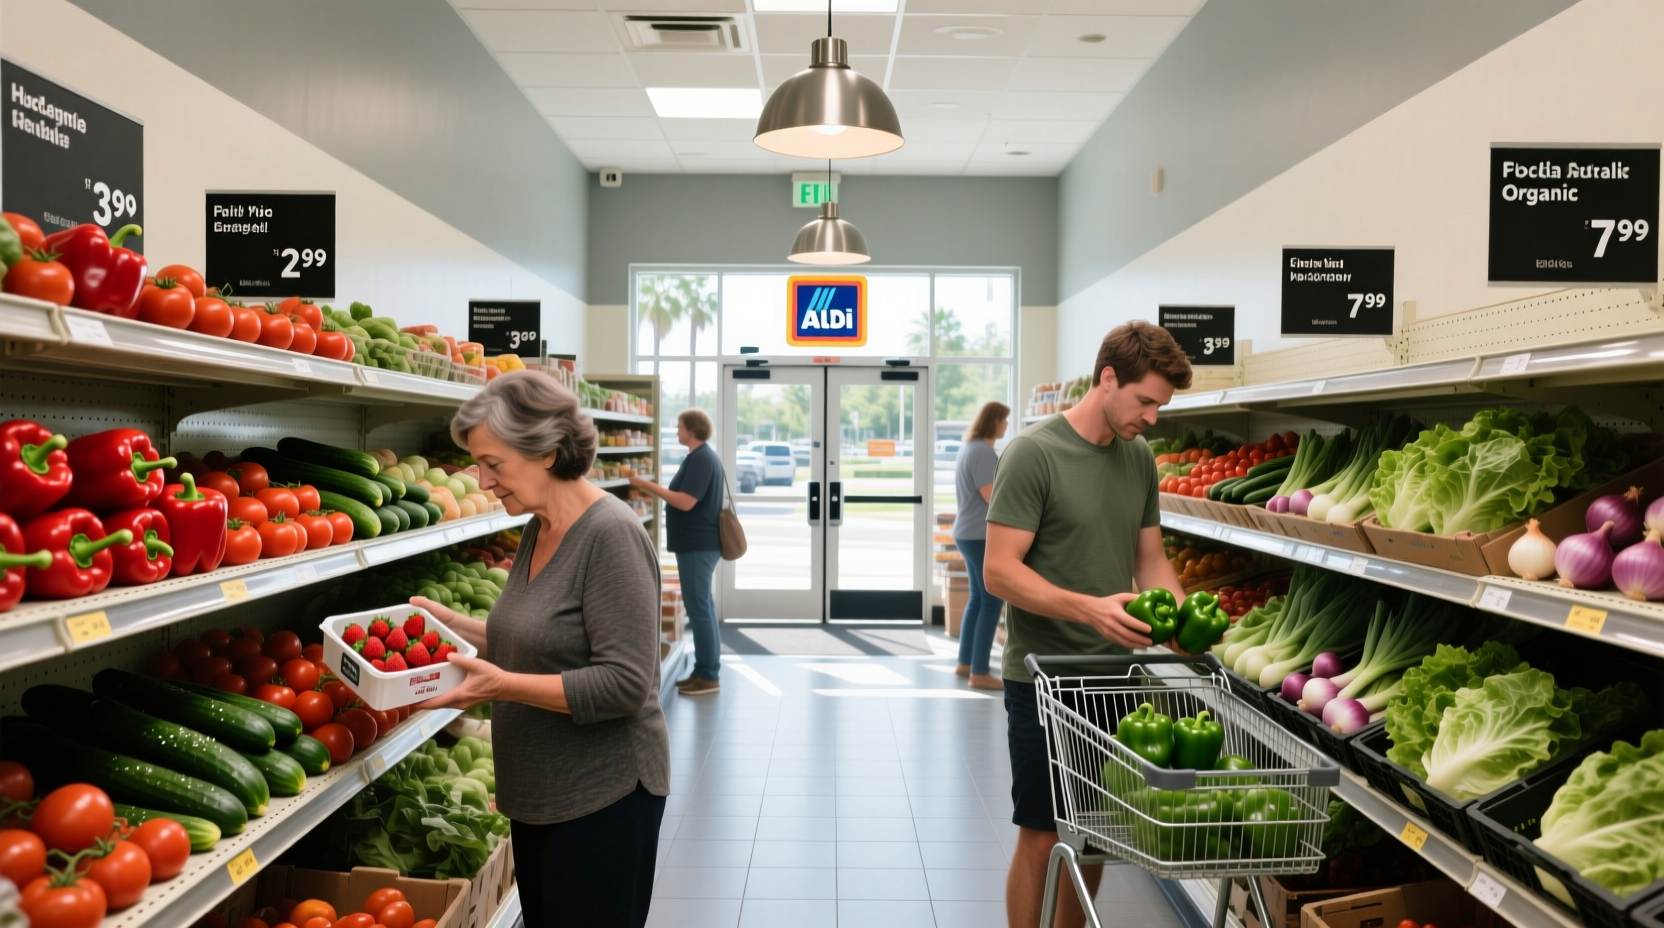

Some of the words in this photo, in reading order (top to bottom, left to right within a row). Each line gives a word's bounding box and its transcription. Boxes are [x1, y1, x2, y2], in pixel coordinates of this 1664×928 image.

[1502, 183, 1579, 206] Organic
[1591, 218, 1649, 258] 799
[281, 247, 327, 278] 299
[1347, 293, 1386, 319] 799
